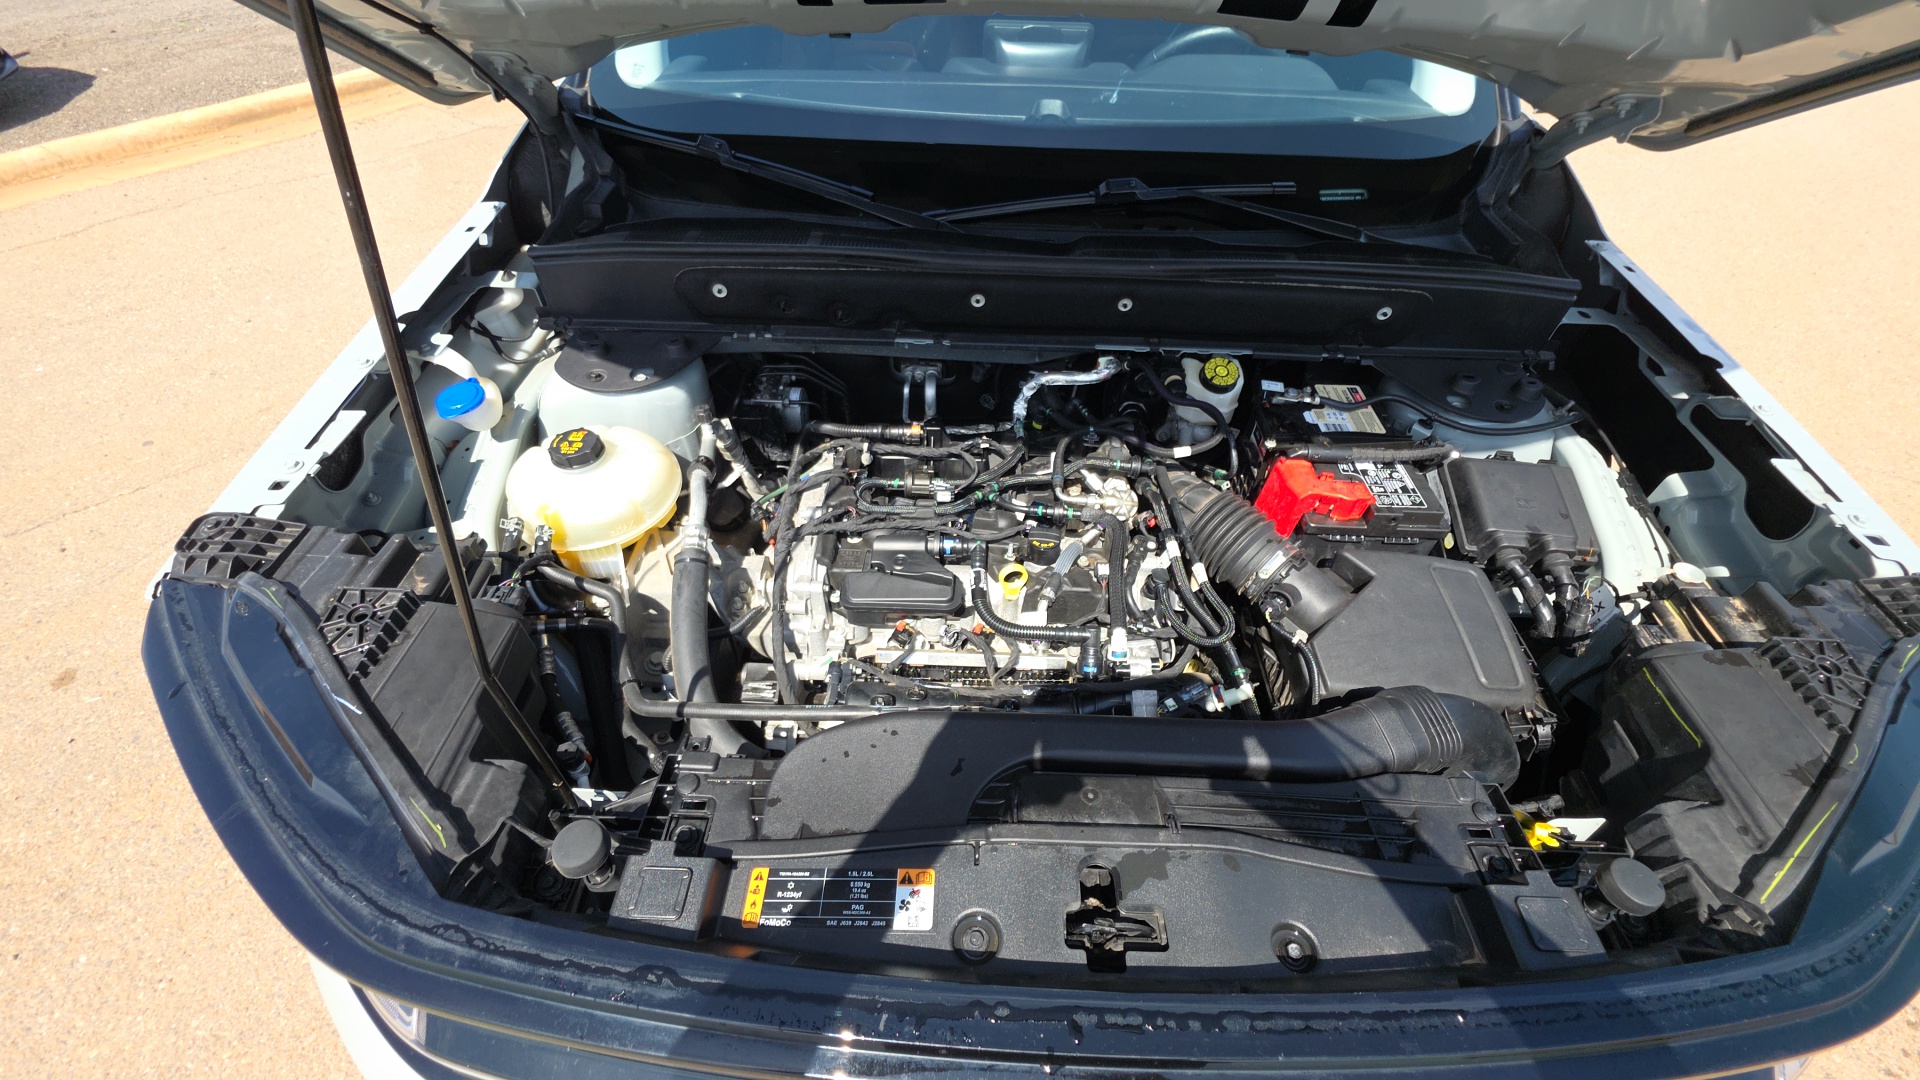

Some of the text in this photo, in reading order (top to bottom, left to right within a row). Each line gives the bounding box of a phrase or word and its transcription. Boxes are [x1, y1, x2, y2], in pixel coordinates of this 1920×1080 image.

[864, 881, 871, 889] kg
[776, 891, 803, 899] R-1234yf
[760, 918, 792, 927] FoMoCo
